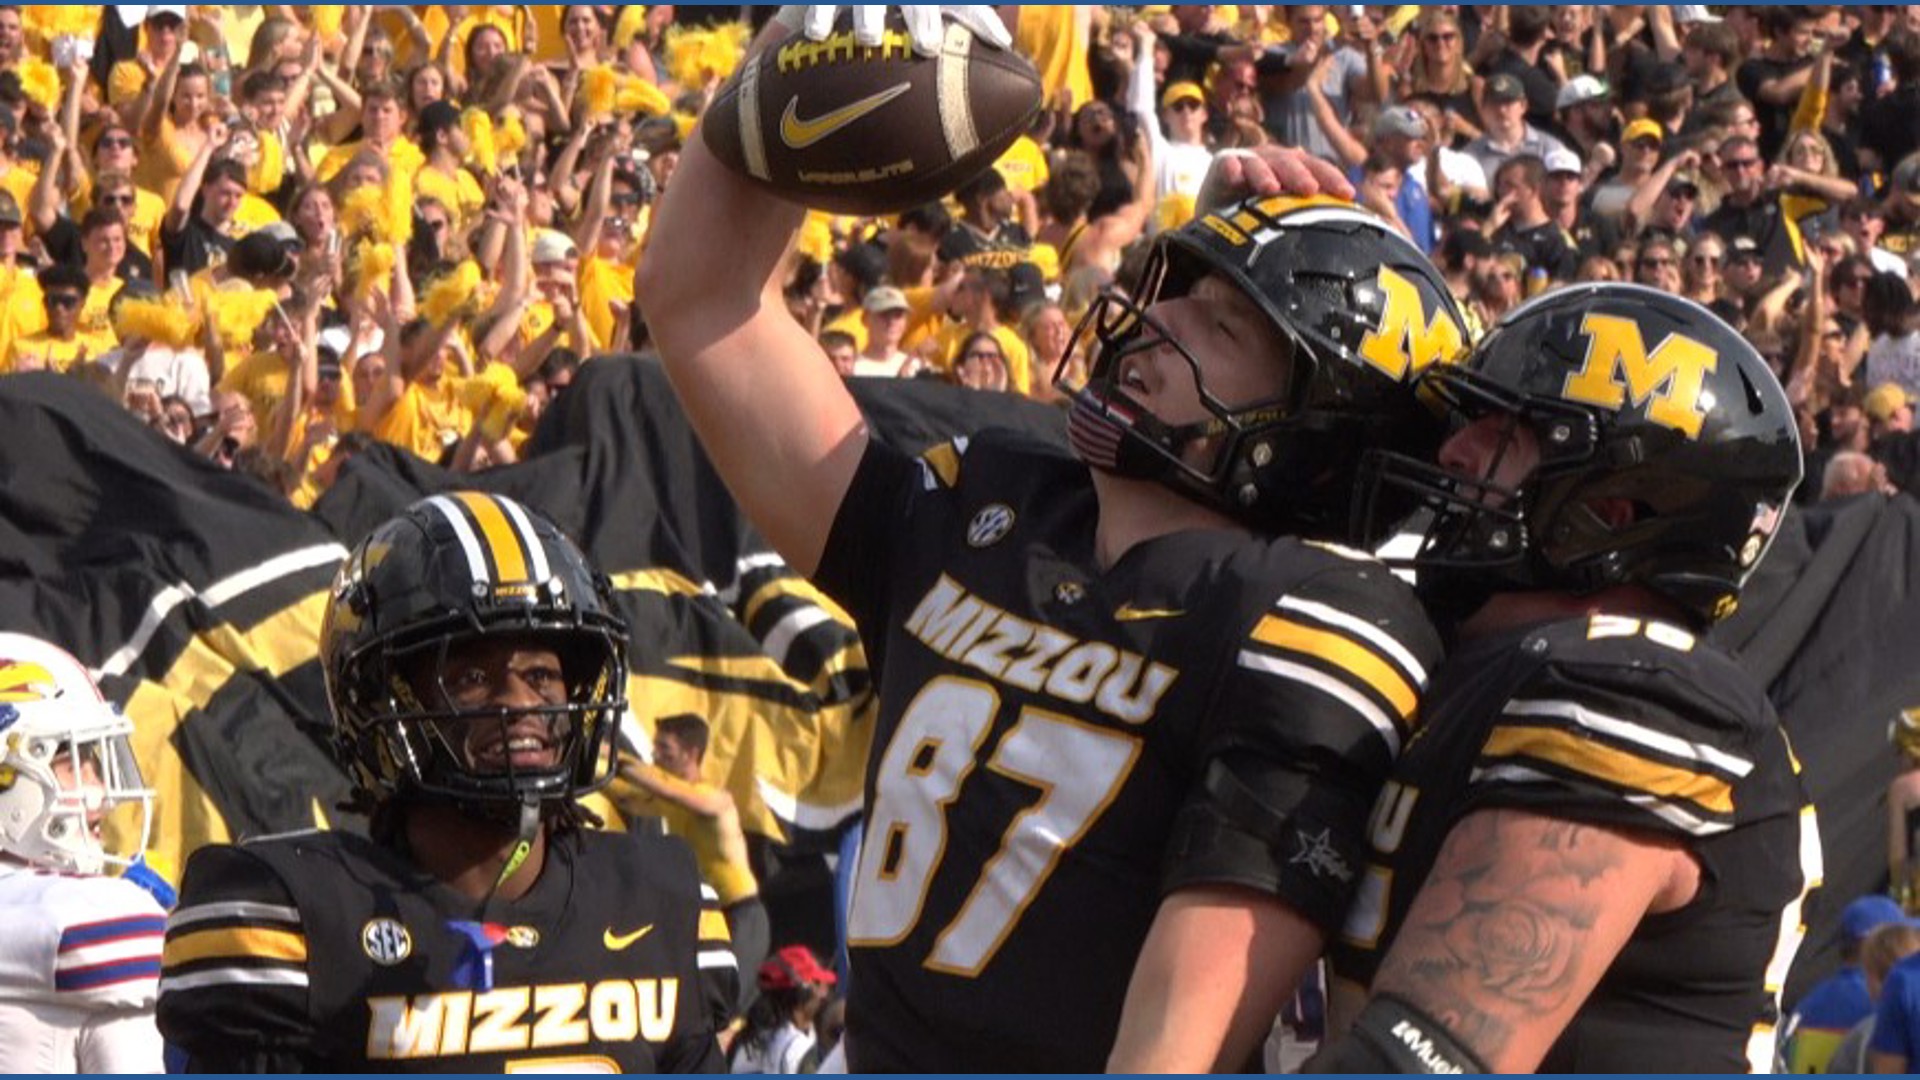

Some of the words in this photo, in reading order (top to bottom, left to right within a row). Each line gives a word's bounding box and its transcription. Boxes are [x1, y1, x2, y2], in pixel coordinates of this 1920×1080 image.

[1560, 312, 1719, 442] M
[903, 570, 1181, 725] MIZZOU
[847, 674, 1145, 978] 87
[366, 920, 408, 961] SEC
[366, 977, 679, 1060] MIZZOU
